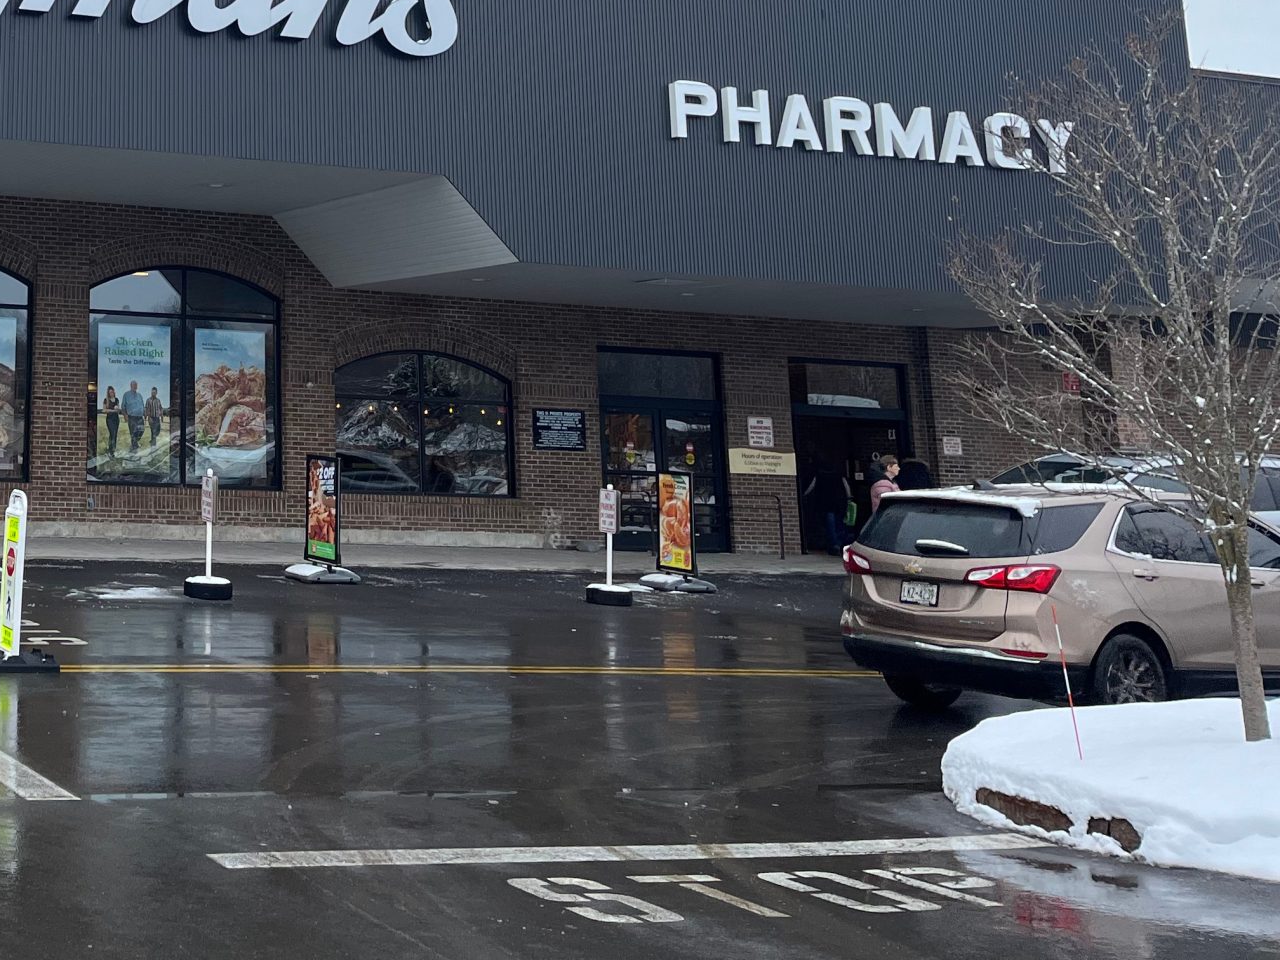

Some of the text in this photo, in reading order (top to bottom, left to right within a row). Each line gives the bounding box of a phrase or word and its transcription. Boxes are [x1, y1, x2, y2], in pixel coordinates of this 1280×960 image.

[668, 79, 1075, 173] PHARMACY
[115, 337, 153, 347] Chicken
[104, 347, 164, 359] Raised Right
[323, 467, 335, 480] OFF
[507, 867, 1003, 923] STOP
